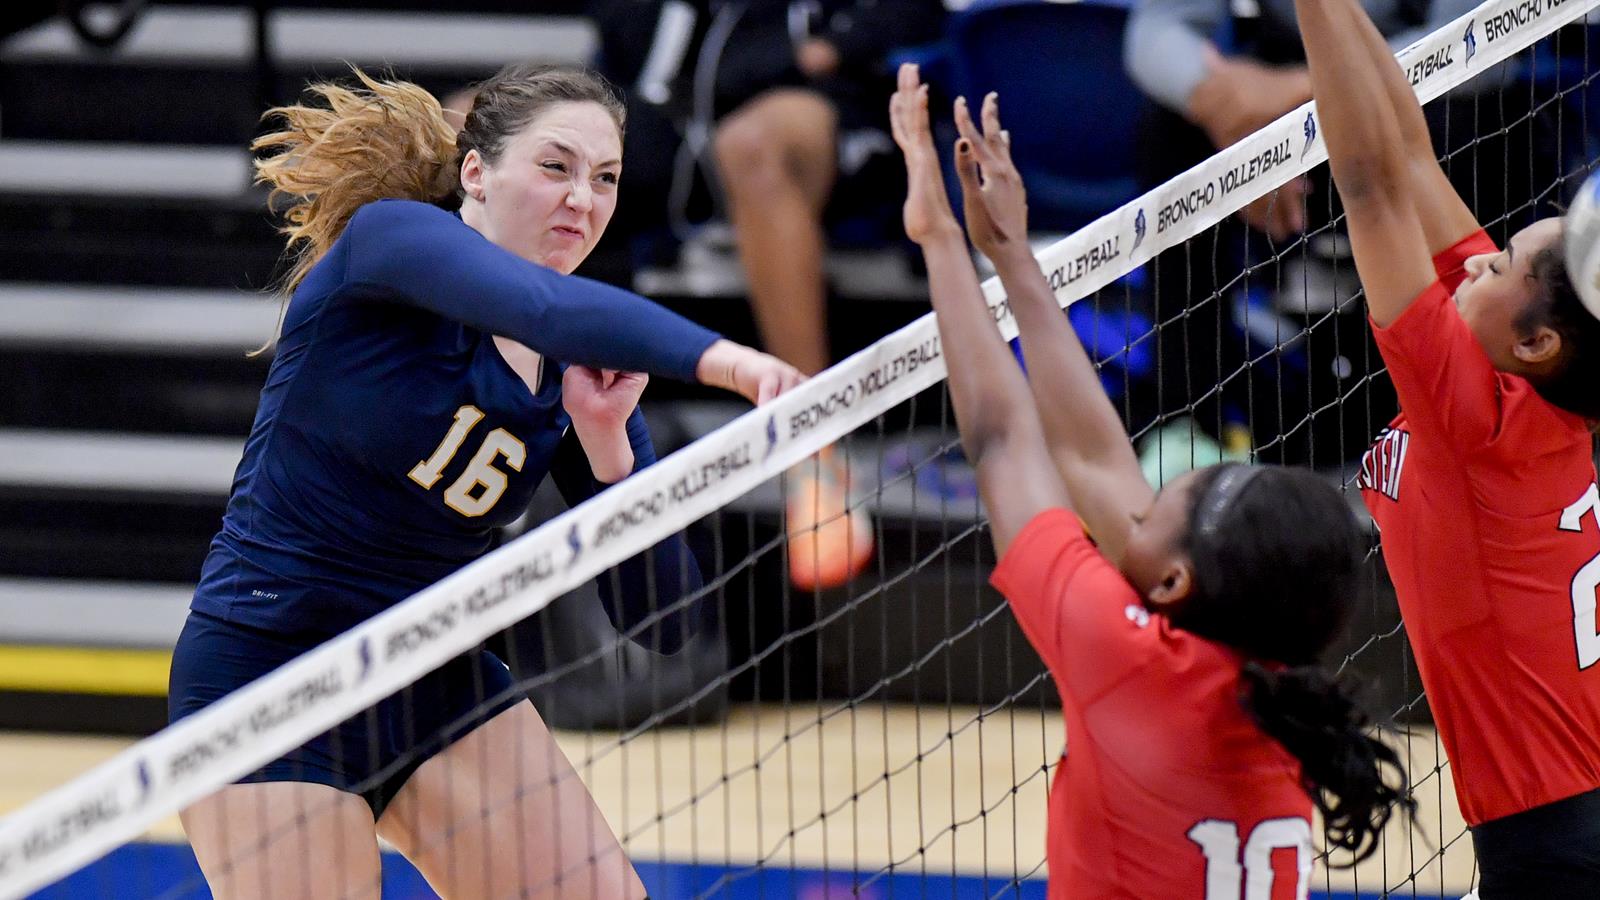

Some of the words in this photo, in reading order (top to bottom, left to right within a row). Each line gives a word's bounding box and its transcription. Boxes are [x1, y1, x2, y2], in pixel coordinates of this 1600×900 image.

[1484, 0, 1542, 43] BRONCHO
[1157, 182, 1215, 234] BRONCHO
[1218, 138, 1292, 198] VOLLEYBALL
[1044, 235, 1120, 292] OLLEYBALL
[790, 386, 856, 438] BRONCHO
[859, 336, 940, 399] VOLLEYBALL
[407, 405, 527, 518] 16
[1184, 816, 1313, 900] 10
